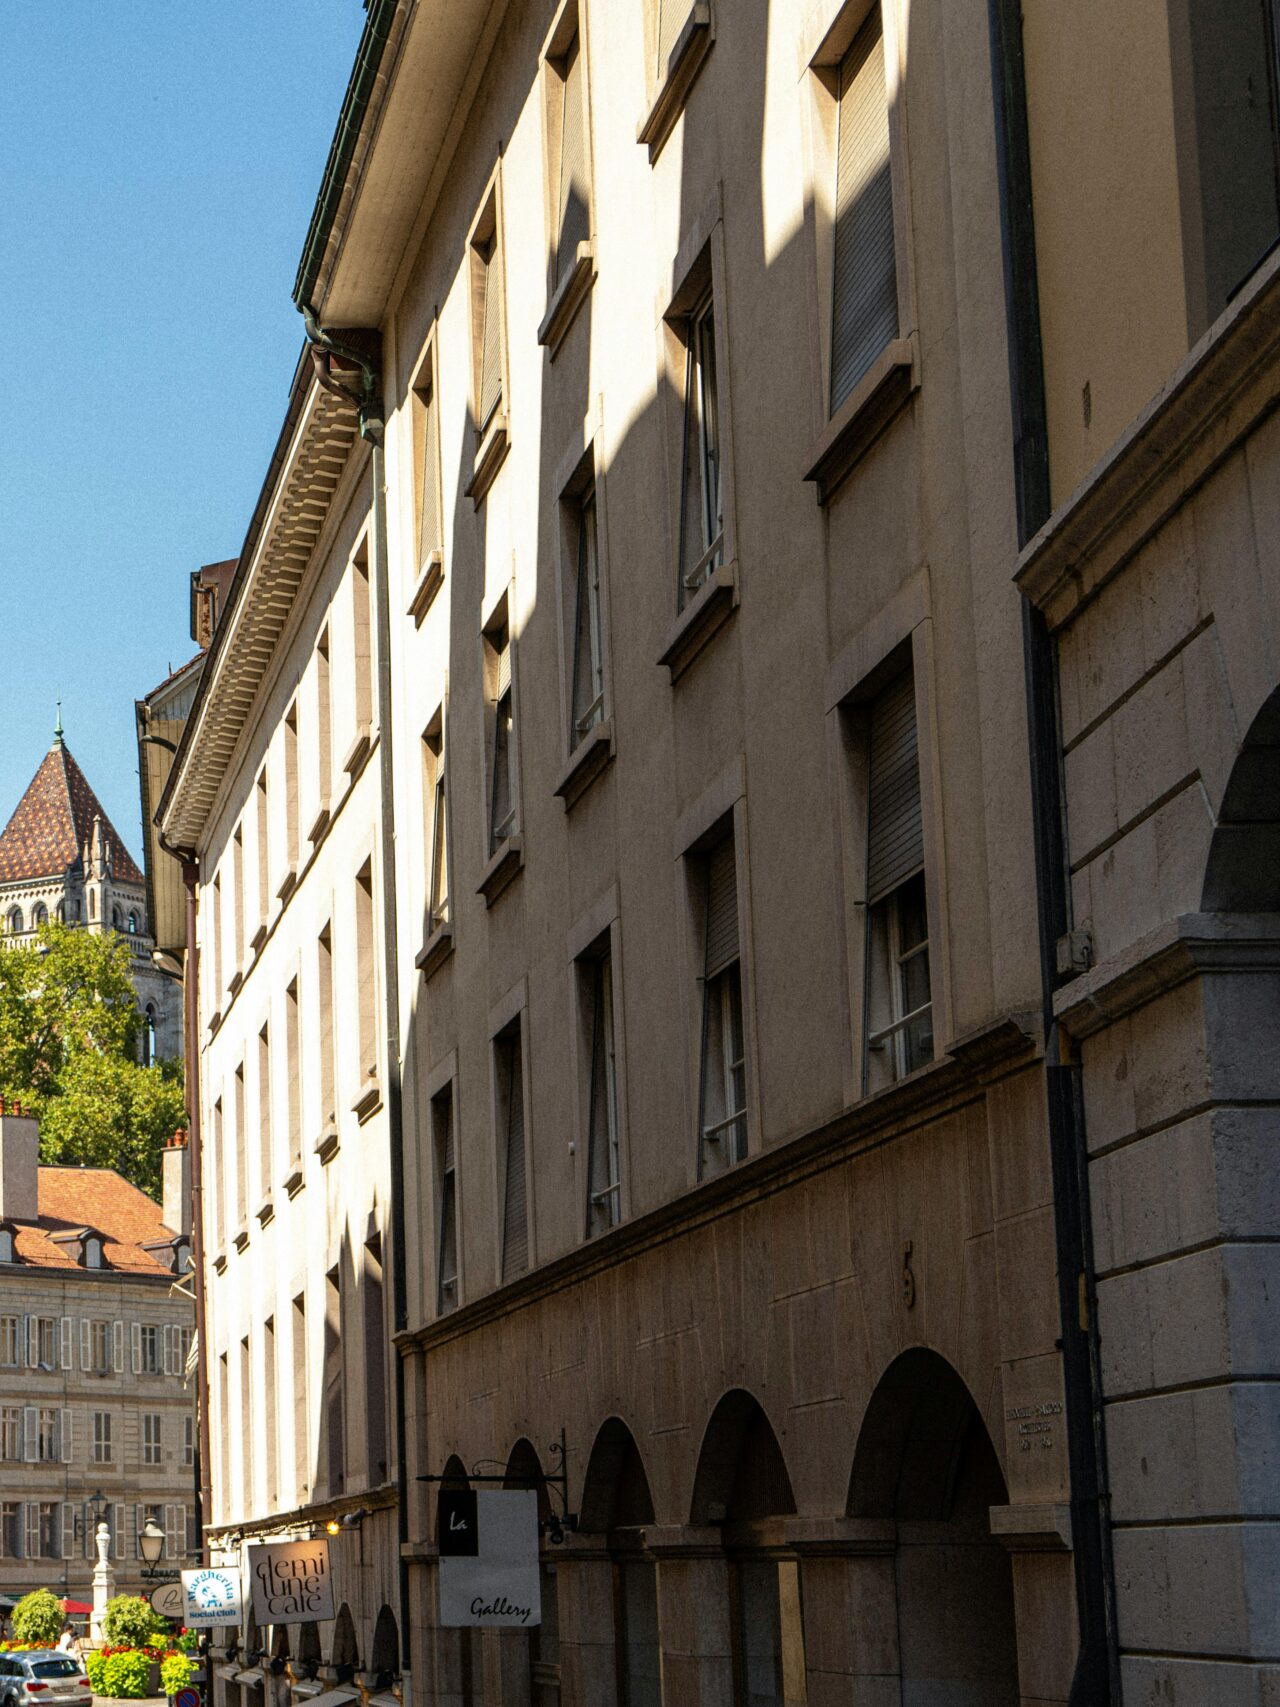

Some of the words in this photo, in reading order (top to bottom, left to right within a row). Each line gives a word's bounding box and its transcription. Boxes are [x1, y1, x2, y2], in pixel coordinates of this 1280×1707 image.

[904, 1239, 916, 1310] 5
[449, 1510, 468, 1531] La
[256, 1552, 325, 1579] demi
[187, 1570, 234, 1602] Margherita
[189, 1611, 215, 1619] Social
[217, 1609, 236, 1617] Club
[470, 1597, 531, 1623] Gallery
